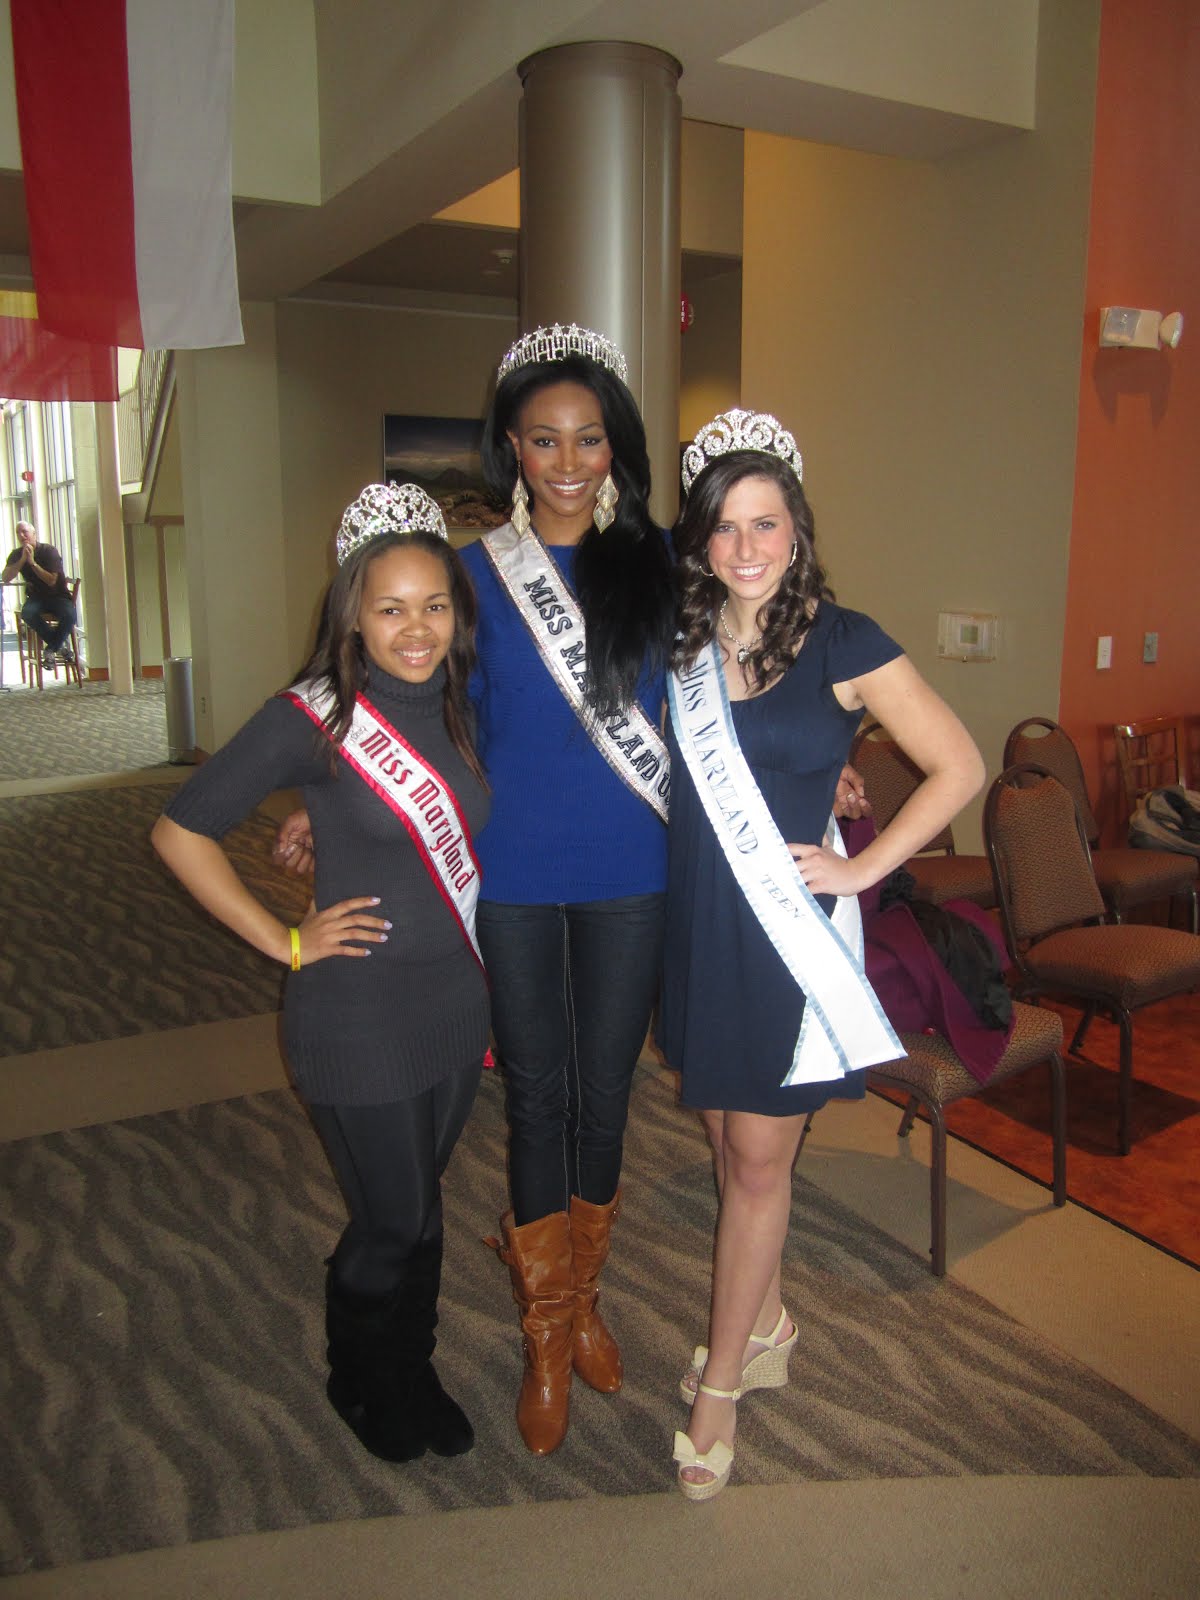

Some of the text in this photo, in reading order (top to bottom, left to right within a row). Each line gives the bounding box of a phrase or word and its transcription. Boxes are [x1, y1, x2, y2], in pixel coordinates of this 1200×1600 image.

[523, 574, 574, 636] MISS
[560, 640, 660, 781] MAYLAND
[359, 728, 477, 893] Miss Maryland
[681, 660, 806, 919] MISS MARYLAND TEEN
